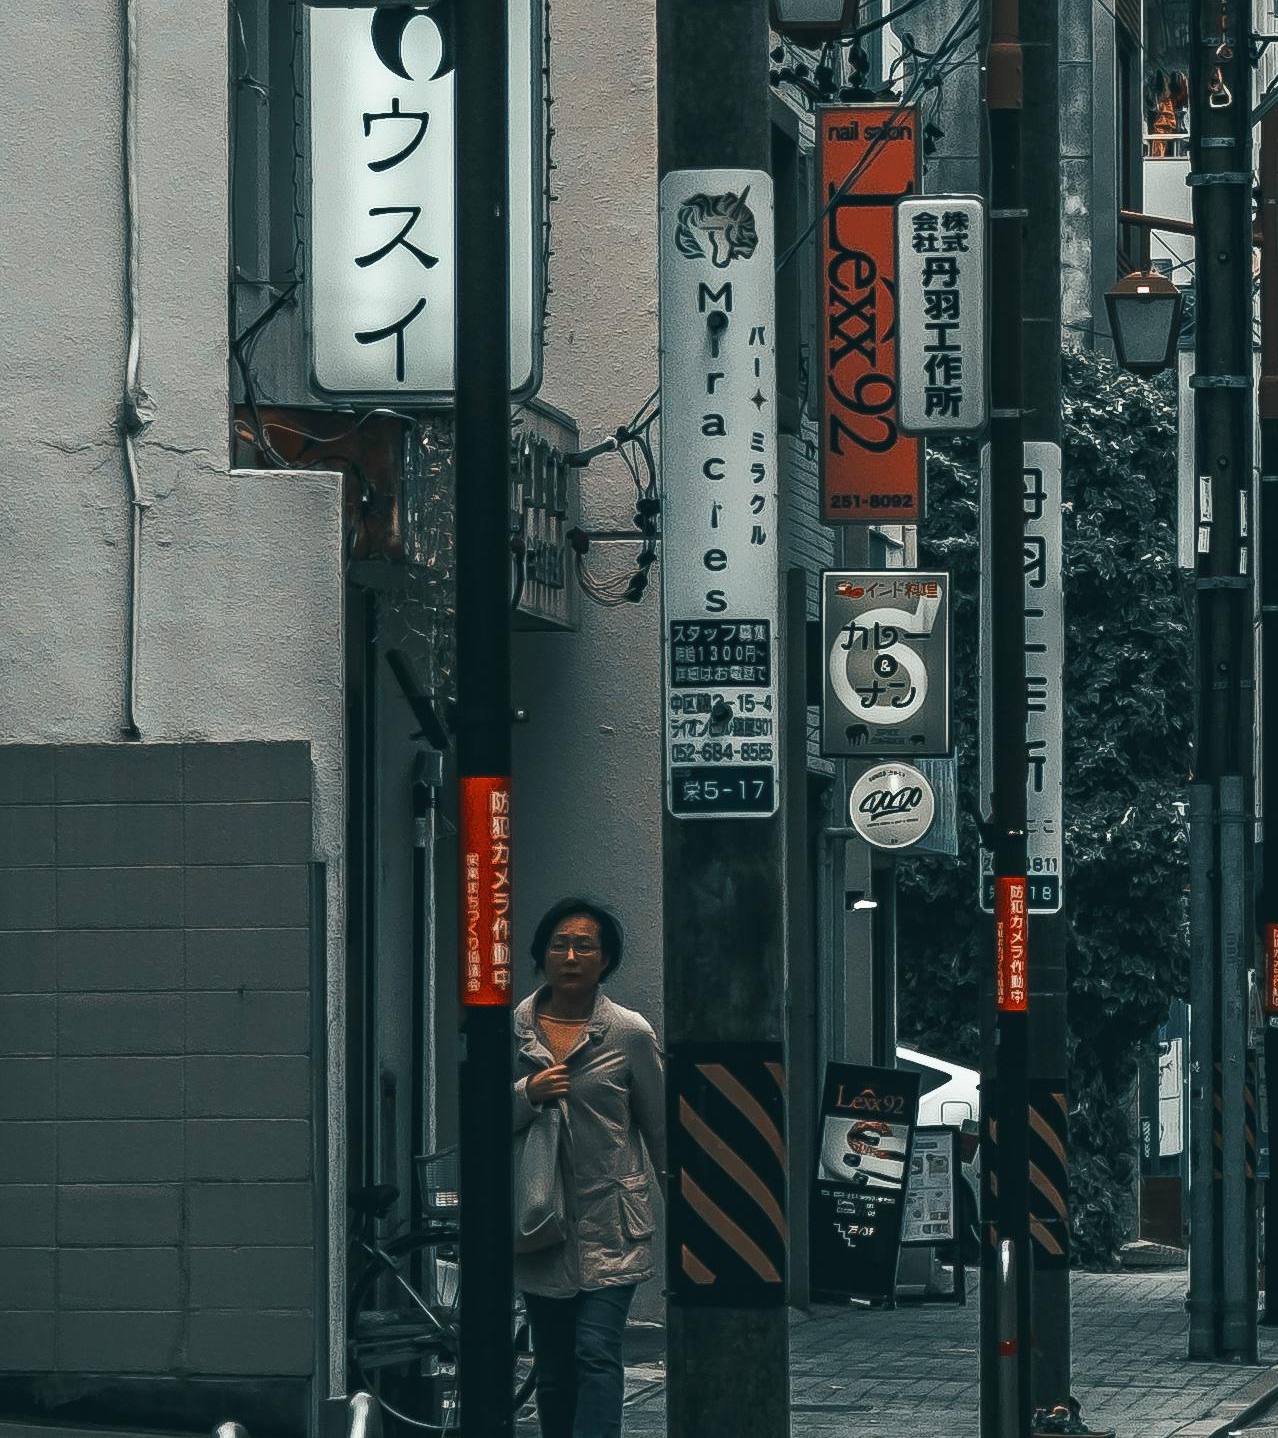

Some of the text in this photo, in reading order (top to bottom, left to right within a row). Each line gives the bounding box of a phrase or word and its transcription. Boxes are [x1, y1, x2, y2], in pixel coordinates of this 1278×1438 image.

[828, 121, 913, 142] nail salon
[355, 98, 439, 382] ウスイ
[923, 256, 963, 418] 丹羽工作所
[750, 432, 766, 545] ミラクル
[830, 494, 914, 509] 251-8092
[866, 581, 938, 599] インド料理
[841, 621, 931, 650] カレー
[855, 680, 916, 708] ナン
[490, 790, 510, 991] 防犯カメラ作動中
[1010, 885, 1024, 1004] 防犯カメラ作動中
